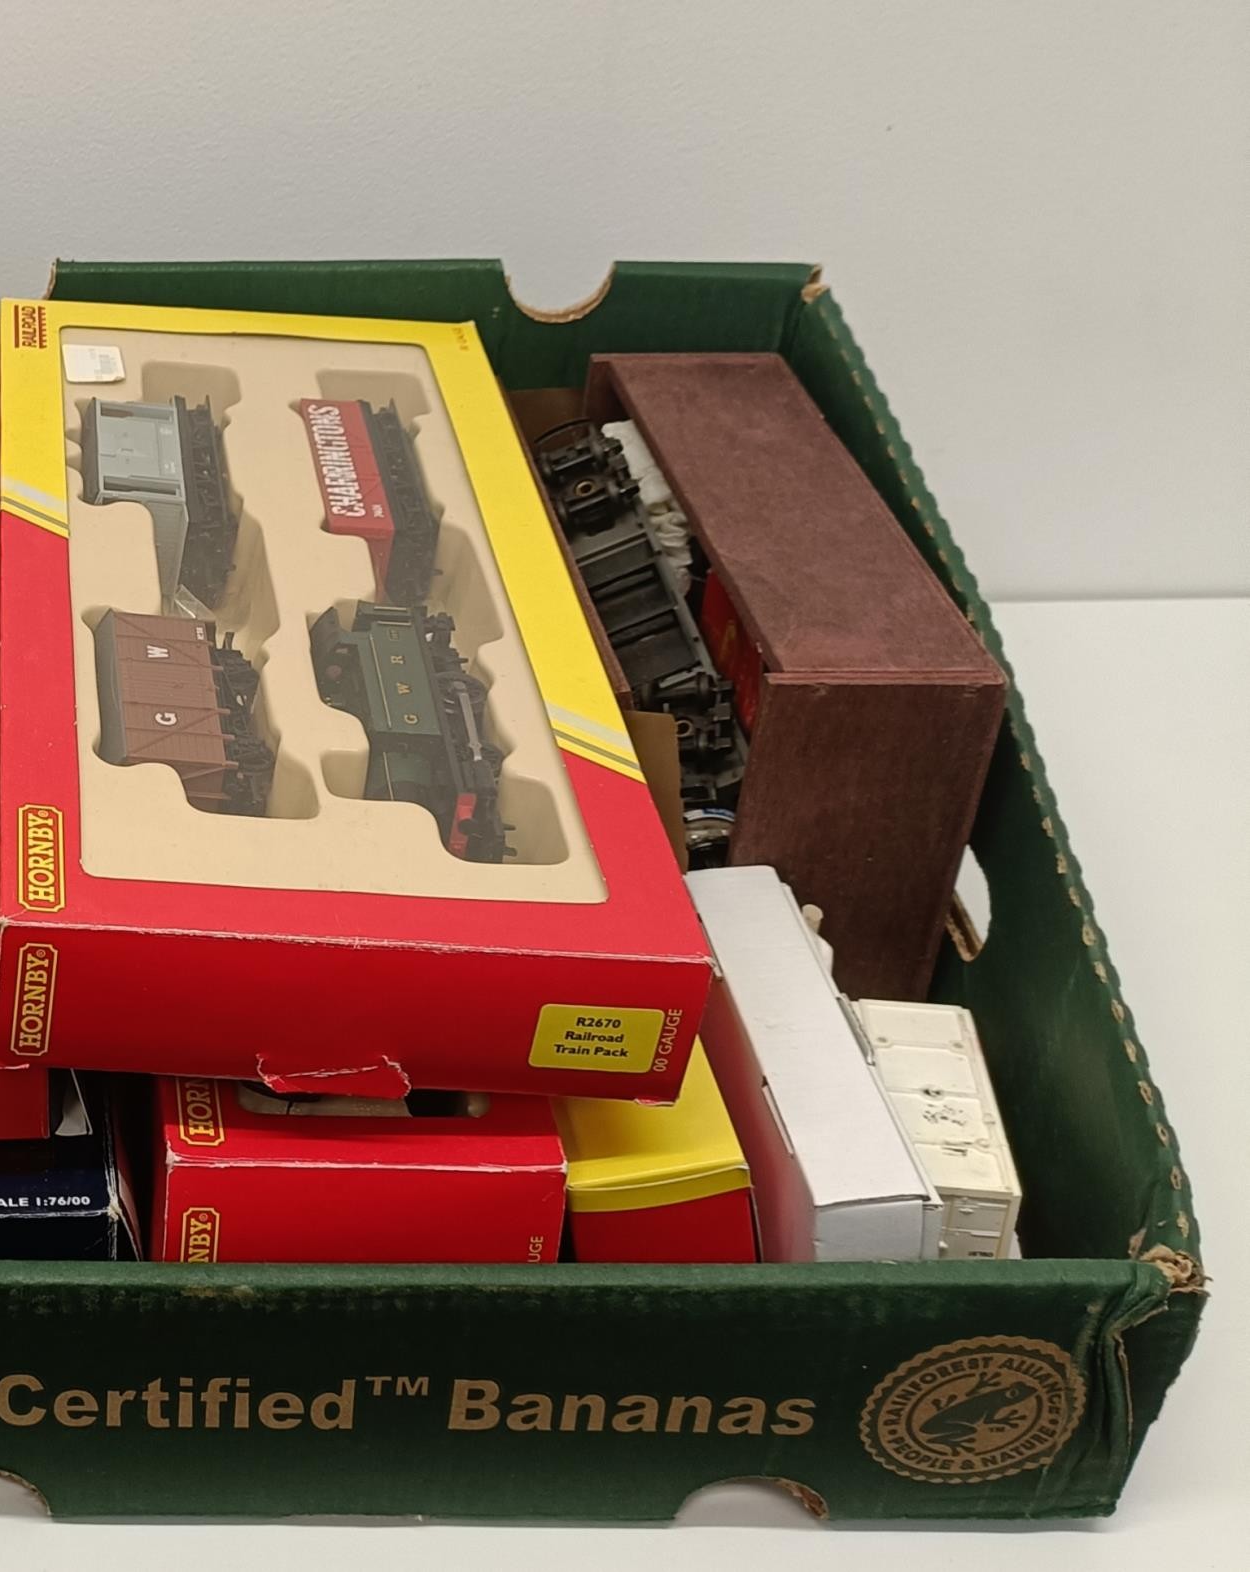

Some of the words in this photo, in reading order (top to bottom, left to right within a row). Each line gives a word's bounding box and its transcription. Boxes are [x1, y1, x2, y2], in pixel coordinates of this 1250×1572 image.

[21, 305, 37, 348] RAILROAD
[146, 645, 168, 658] W
[155, 712, 177, 725] G
[575, 1016, 622, 1029] R2670
[564, 1030, 625, 1043] Railroad
[658, 1008, 683, 1055] GAUGE
[554, 1044, 590, 1056] Train
[593, 1046, 629, 1058] Pack
[35, 1196, 91, 1207] 1:76/00
[883, 1356, 994, 1427] RAINFOREST
[998, 1357, 1064, 1426] ALLIANCE
[447, 1378, 818, 1436] Bananas
[886, 1437, 952, 1470] PEOPLE
[959, 1459, 976, 1471] &
[981, 1425, 1057, 1468] NATURE
